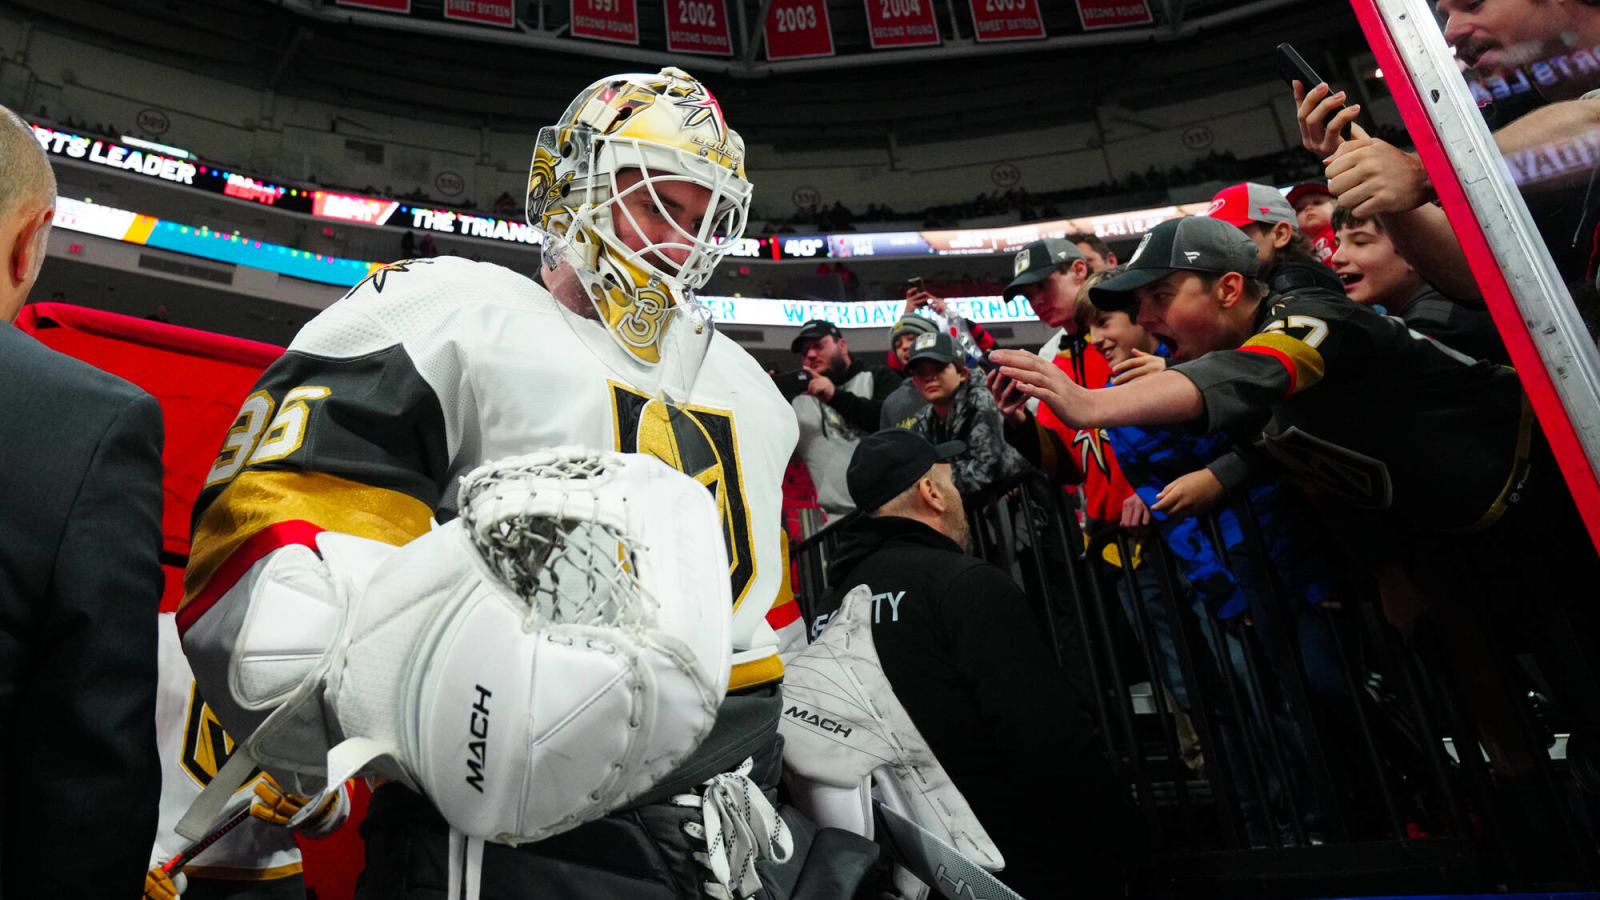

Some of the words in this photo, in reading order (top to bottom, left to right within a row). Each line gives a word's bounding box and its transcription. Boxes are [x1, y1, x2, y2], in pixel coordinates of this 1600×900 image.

[678, 0, 717, 27] 2002
[775, 5, 817, 33] 2003
[880, 0, 921, 19] 2004
[34, 127, 90, 158] RTS
[89, 140, 197, 185] LEADER
[412, 207, 455, 232] THE
[459, 213, 543, 245] TRIANG
[616, 287, 669, 348] 3
[783, 302, 898, 325] WEEKDAY
[203, 385, 332, 490] 36
[465, 684, 492, 794] MACH
[784, 706, 852, 738] MACH
